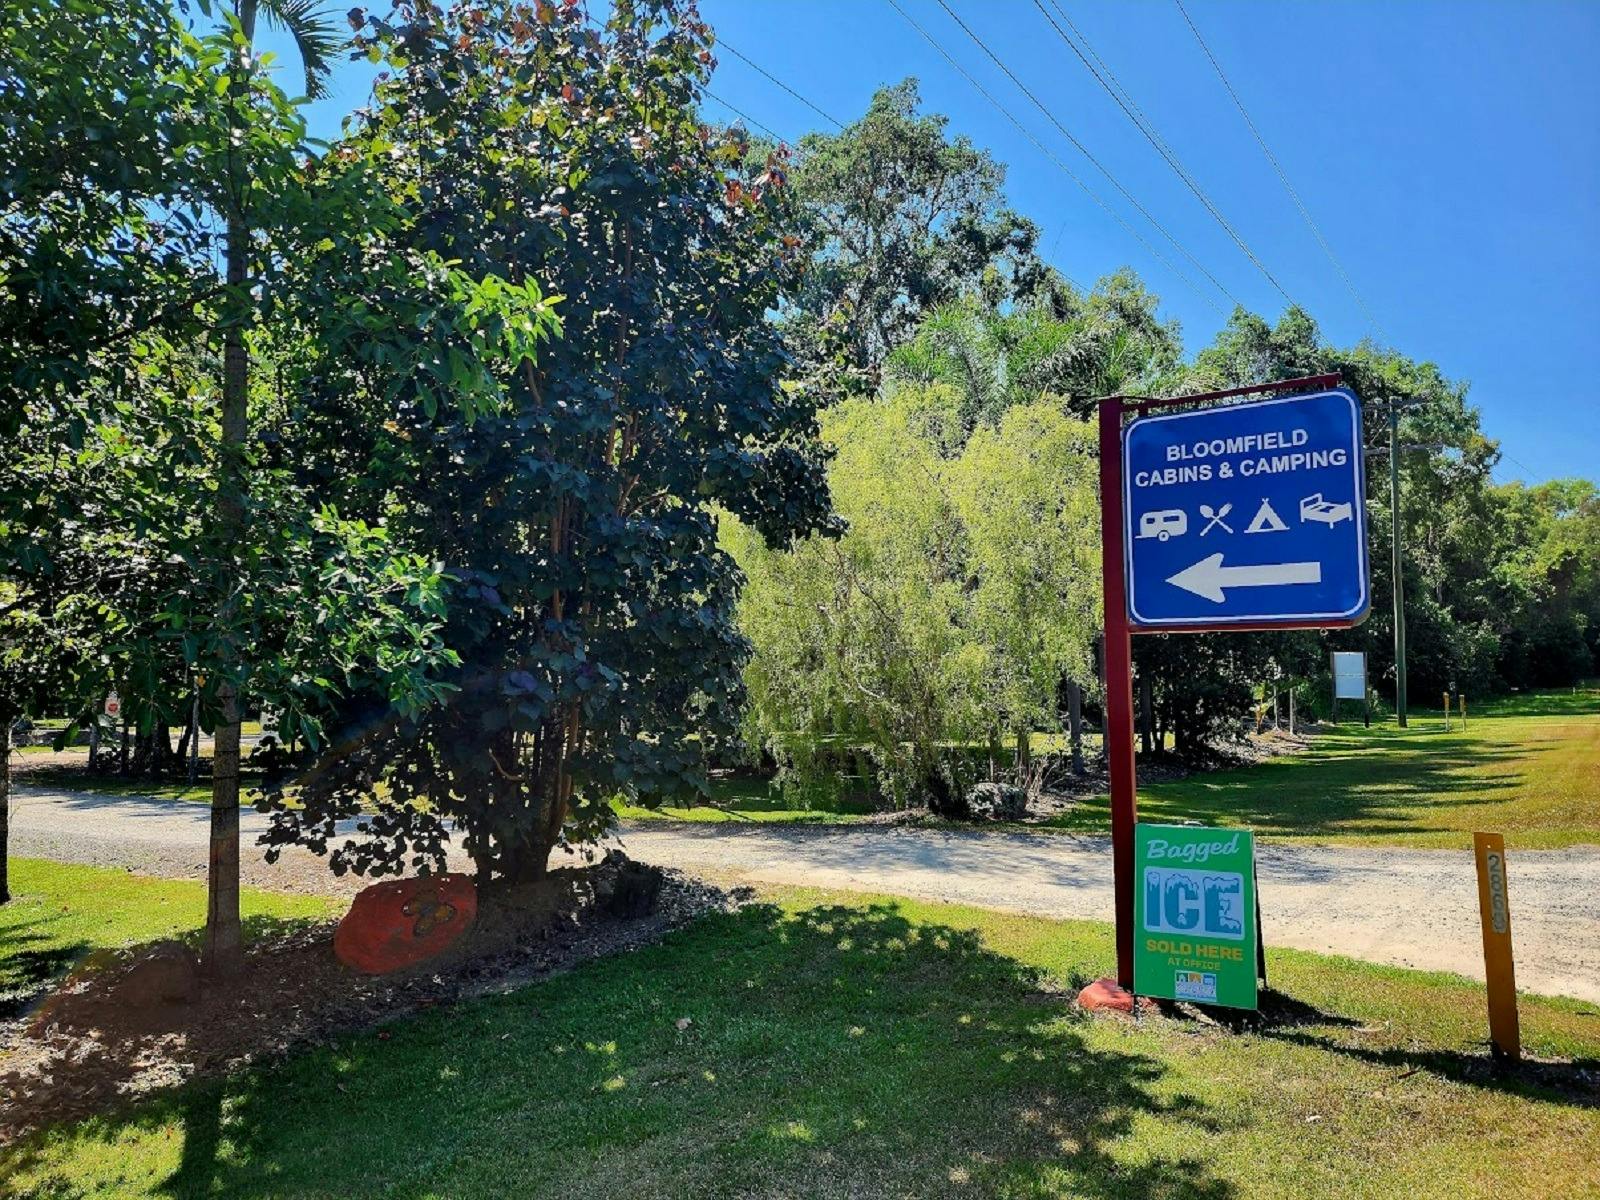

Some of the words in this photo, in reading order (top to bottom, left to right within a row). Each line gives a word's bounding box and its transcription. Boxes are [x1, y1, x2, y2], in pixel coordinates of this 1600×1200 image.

[1166, 429, 1308, 461] BLOOMFIELD
[1135, 465, 1212, 486] CABINS
[1219, 461, 1234, 479] &
[1240, 449, 1346, 476] CAMPING
[1146, 833, 1240, 863] Bagged
[1146, 871, 1242, 935] ICE
[1146, 940, 1192, 956] SOLD
[1195, 943, 1244, 961] HERE
[1167, 957, 1182, 967] AT
[1183, 958, 1221, 971] OFFICE
